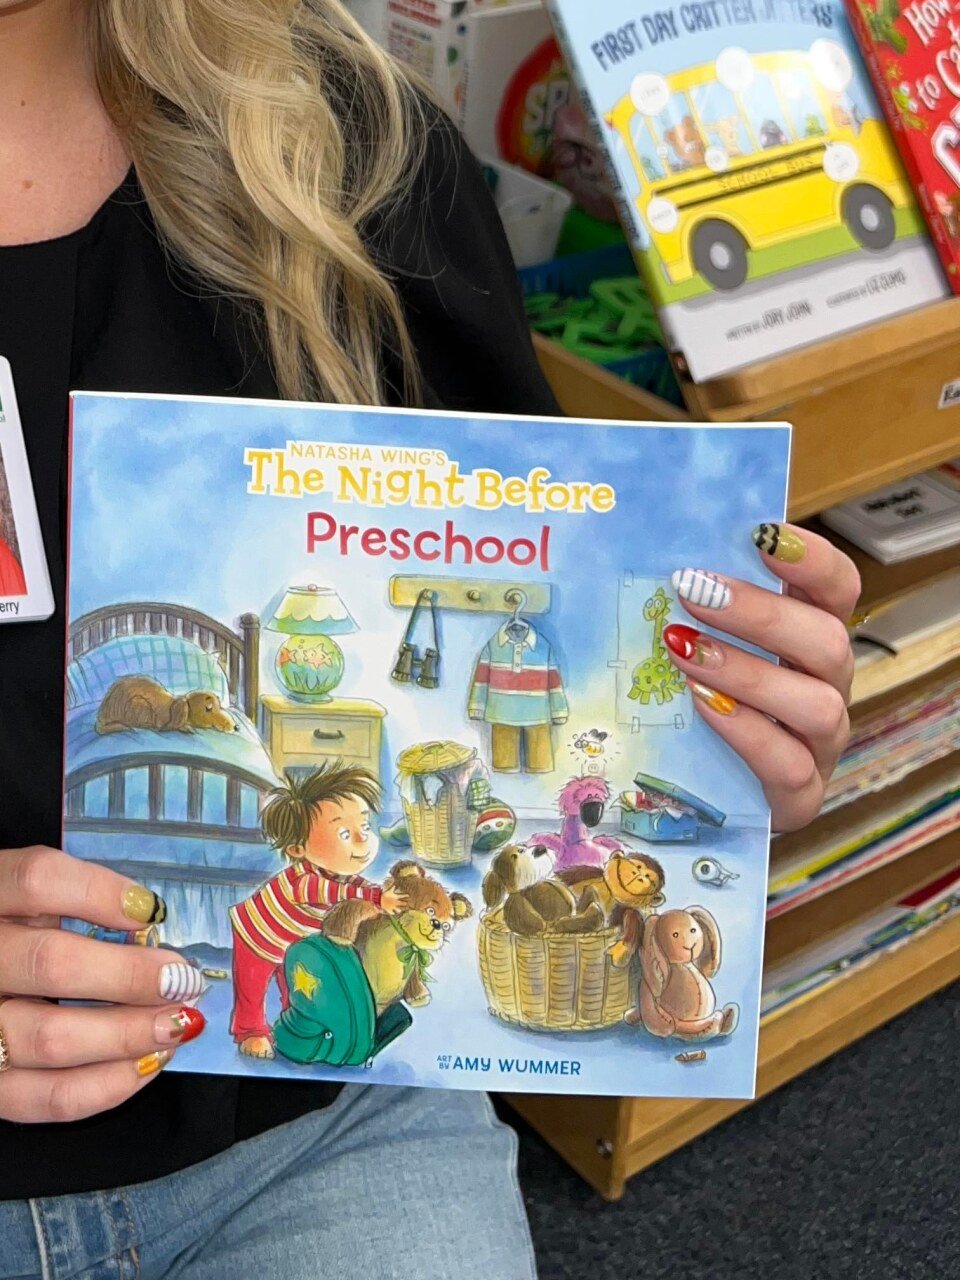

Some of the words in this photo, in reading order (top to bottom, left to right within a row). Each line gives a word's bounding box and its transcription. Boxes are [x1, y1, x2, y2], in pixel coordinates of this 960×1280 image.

[590, 20, 643, 72] FIRST
[642, 7, 680, 46] DAY
[916, 73, 941, 111] to
[290, 442, 373, 463] NATASHA
[381, 448, 446, 467] WING'S
[247, 451, 325, 495] The
[337, 464, 465, 508] Night
[476, 470, 615, 511] Before
[306, 512, 551, 572] Preschool
[436, 1055, 452, 1063] ART
[438, 1062, 450, 1070] BY
[452, 1056, 491, 1072] AMY
[498, 1058, 582, 1076] WUMMER
